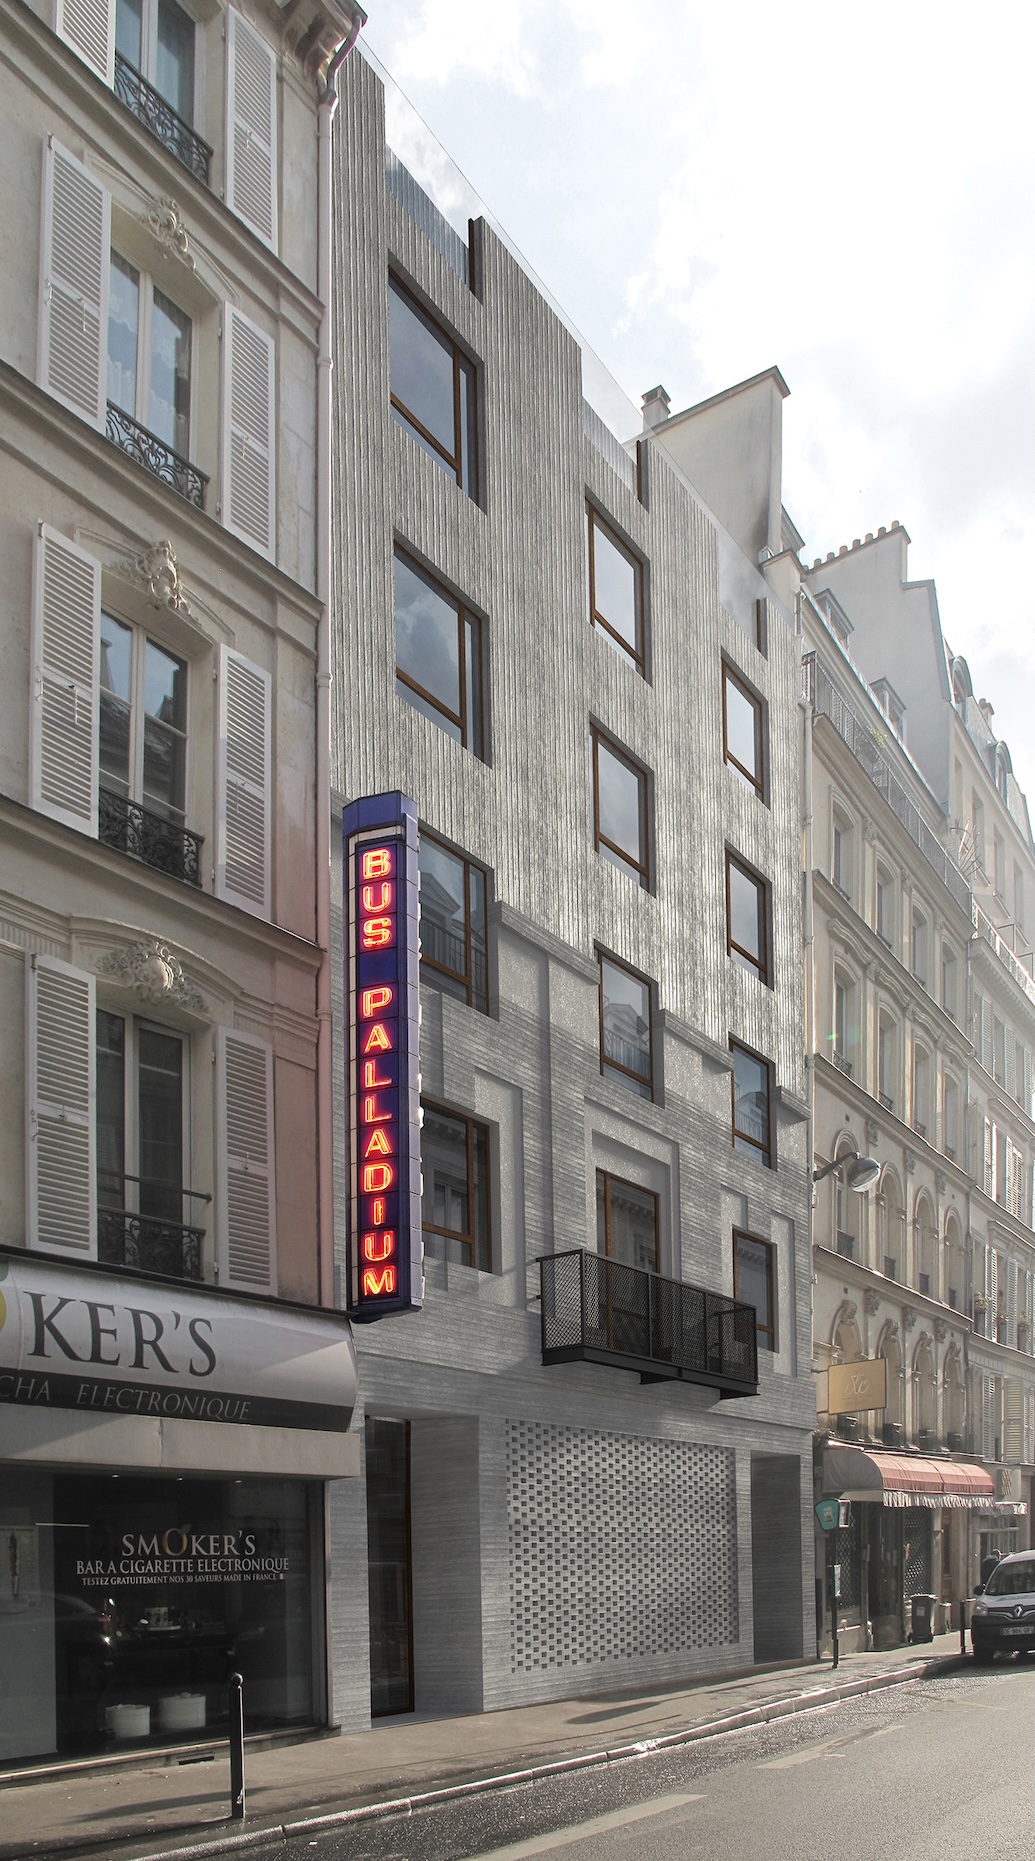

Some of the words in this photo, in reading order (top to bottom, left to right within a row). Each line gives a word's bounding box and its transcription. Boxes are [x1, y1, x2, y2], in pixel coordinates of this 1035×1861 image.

[362, 848, 392, 947] BUS
[362, 985, 394, 1297] PALLADIUM
[0, 1289, 217, 1377] KER'S
[76, 1383, 251, 1420] ELECTRONIQUE
[121, 1527, 257, 1557] SMOKER'S
[76, 1560, 104, 1575] BAR
[107, 1560, 117, 1574] A
[119, 1559, 194, 1574] CIGARETTE
[197, 1558, 289, 1573] ELECTRONIQUE
[82, 1577, 109, 1586] TESTEZ
[110, 1575, 168, 1586] GRATUITEMENT
[169, 1575, 184, 1583] NOS
[185, 1575, 193, 1583] 30
[194, 1574, 222, 1583] SAVEURS
[223, 1573, 242, 1582] MADE
[243, 1573, 251, 1581] IN
[252, 1572, 276, 1581] FRANCE
